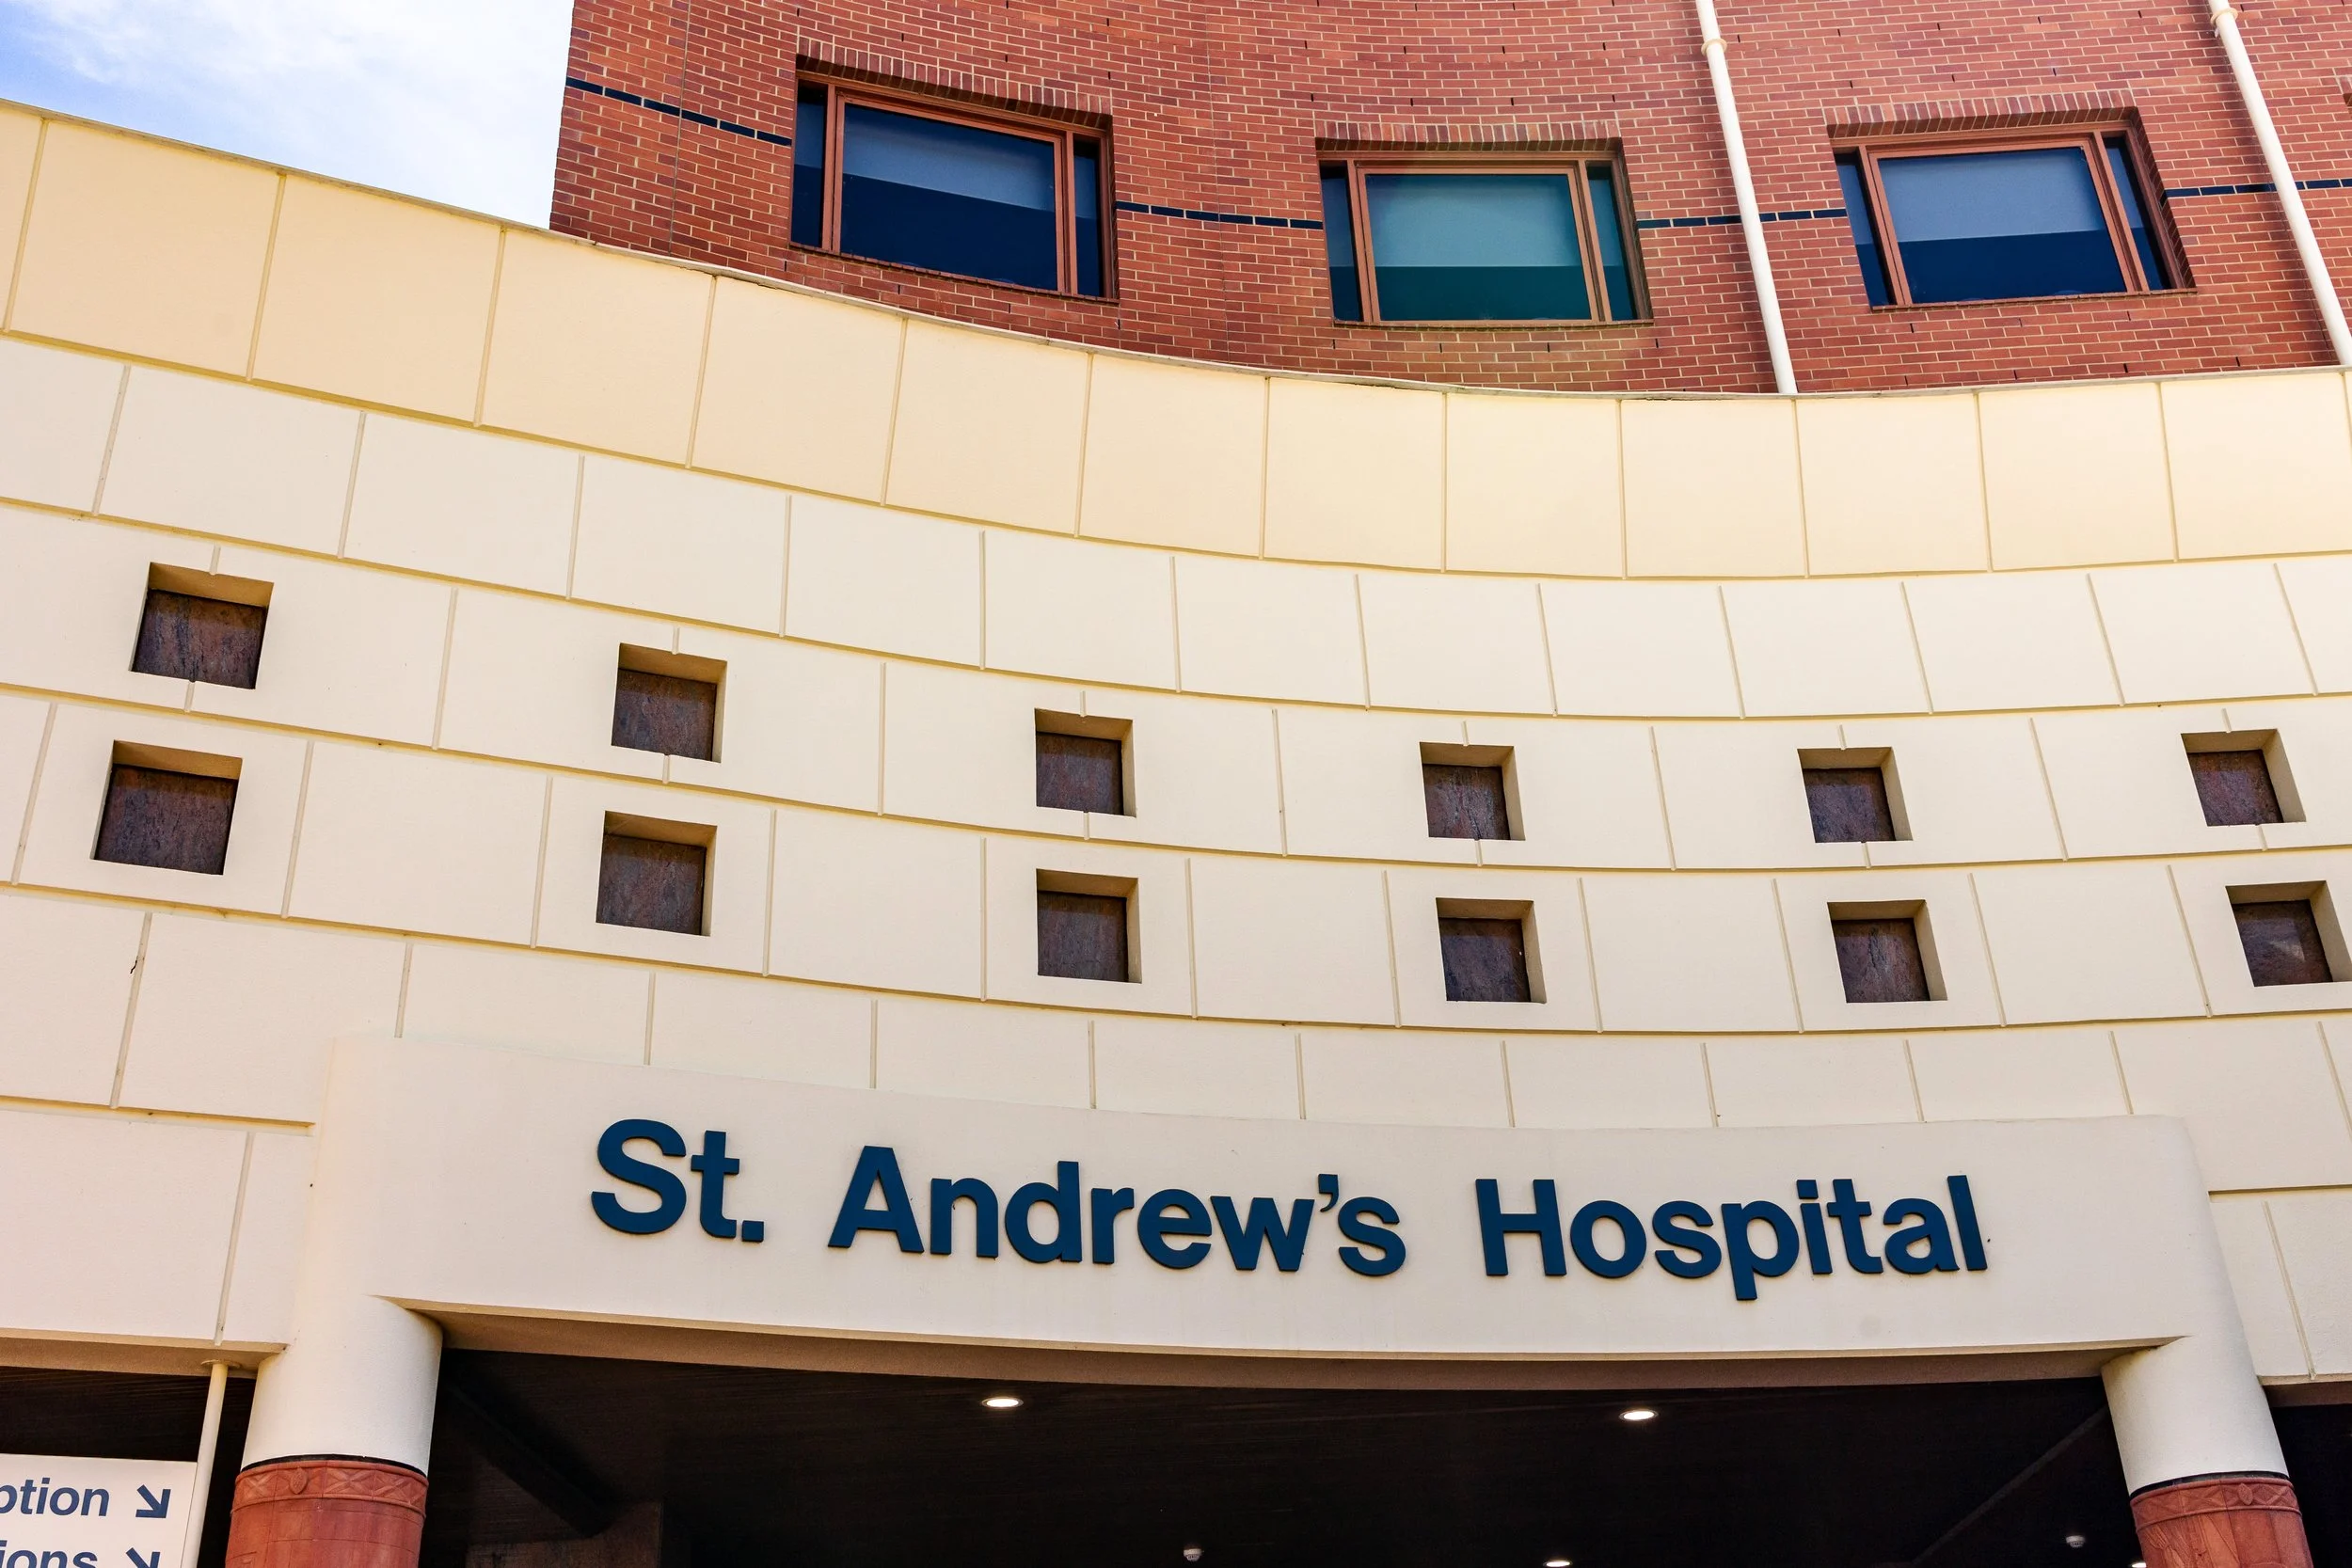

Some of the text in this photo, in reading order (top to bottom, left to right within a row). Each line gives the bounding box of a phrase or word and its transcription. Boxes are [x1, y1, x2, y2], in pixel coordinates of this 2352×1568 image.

[591, 1118, 1988, 1303] St. Andrew’s Hospital
